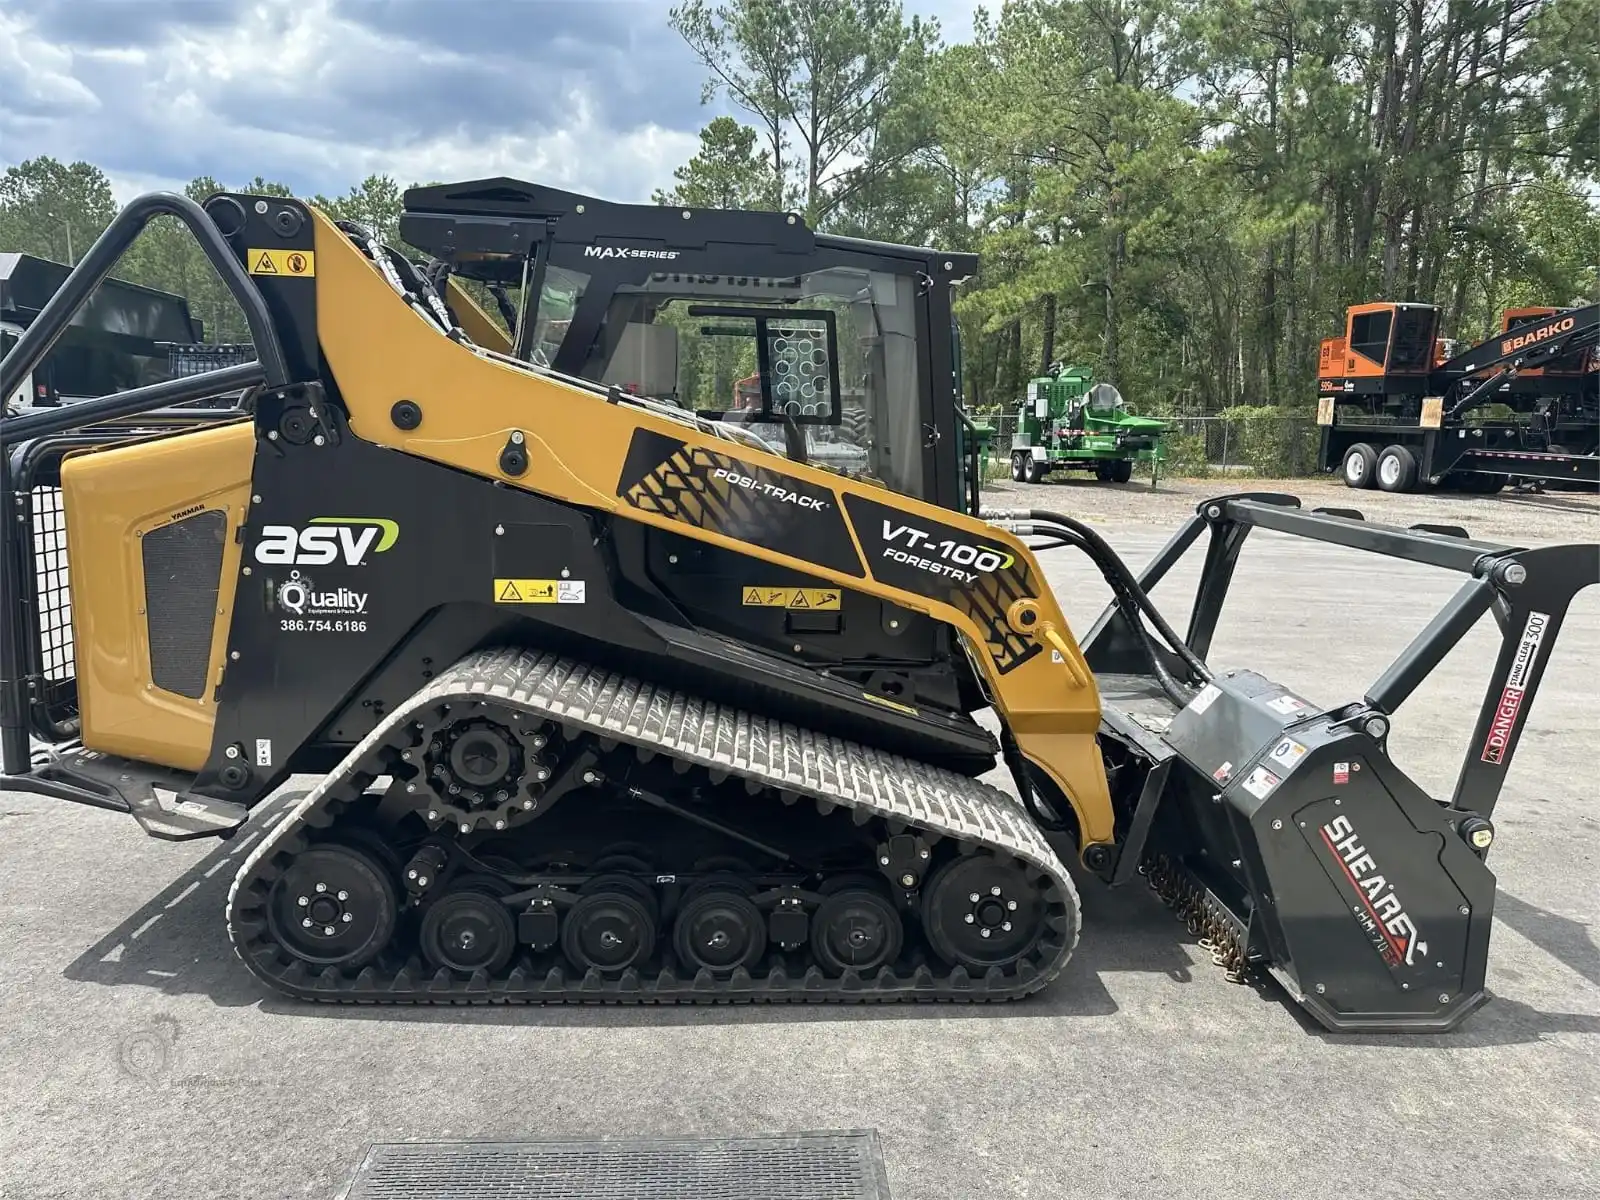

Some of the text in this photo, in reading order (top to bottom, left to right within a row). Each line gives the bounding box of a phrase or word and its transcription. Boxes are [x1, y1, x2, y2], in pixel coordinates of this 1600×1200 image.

[584, 241, 677, 260] MAX-SERIES
[1513, 317, 1575, 349] BARKO
[713, 468, 826, 511] POSI-TRACK
[171, 503, 206, 520] YANMAR
[882, 520, 1001, 573] VT-100
[883, 548, 979, 583] FORESTRY
[282, 585, 368, 615] Quality
[280, 619, 367, 632] 386.754.6186
[1490, 689, 1521, 748] DANGER
[1510, 663, 1524, 687] STAND
[1517, 640, 1531, 664] CLEAR
